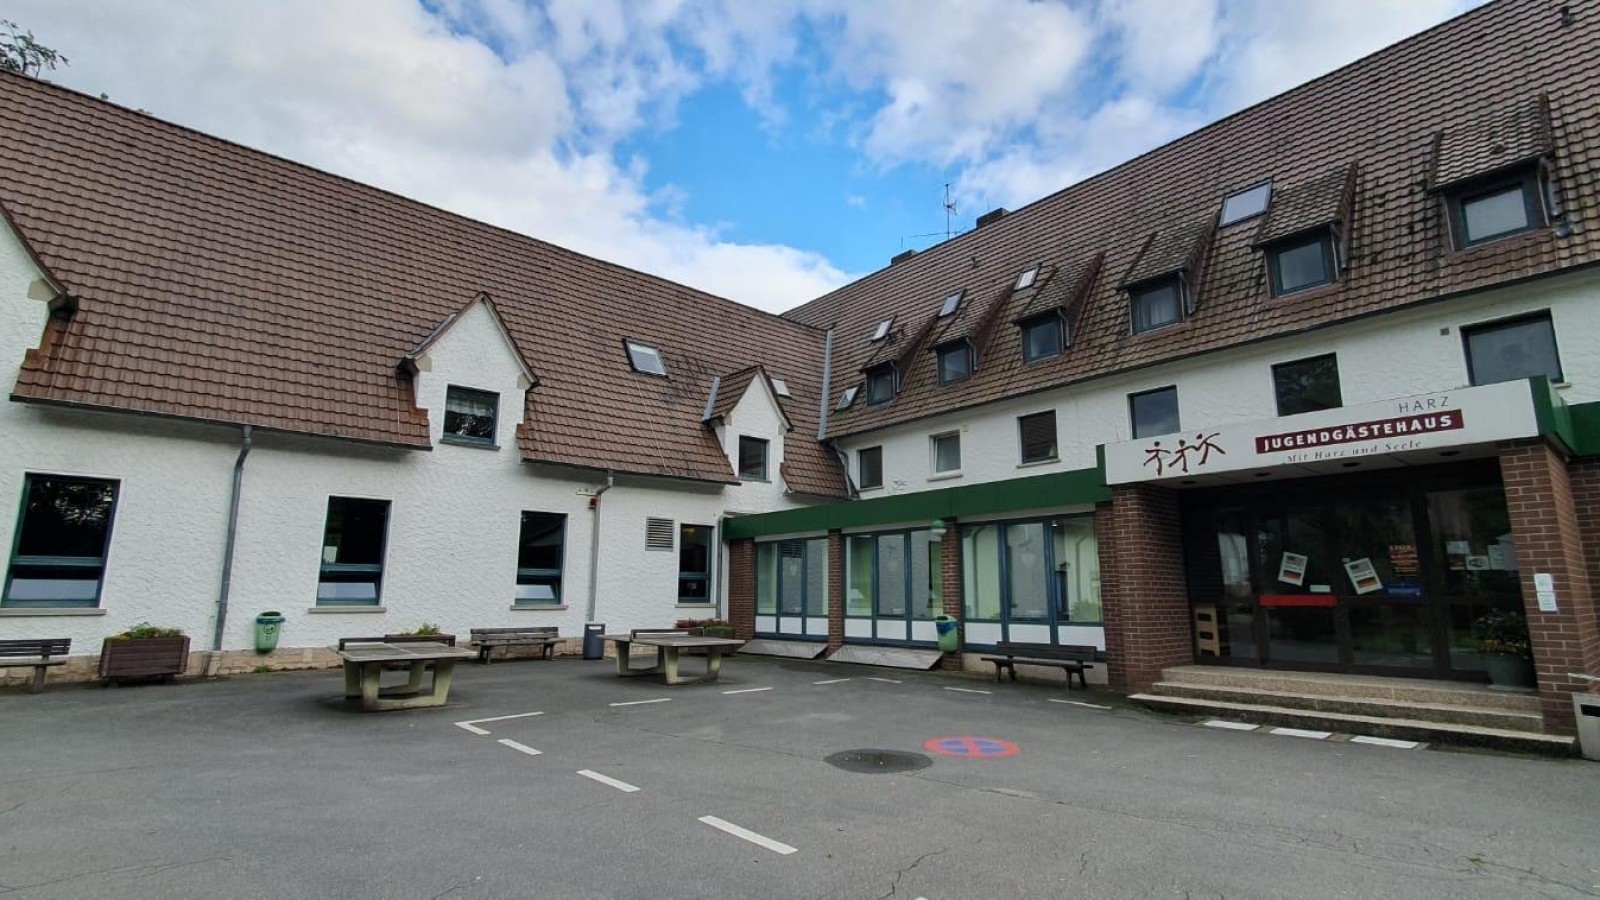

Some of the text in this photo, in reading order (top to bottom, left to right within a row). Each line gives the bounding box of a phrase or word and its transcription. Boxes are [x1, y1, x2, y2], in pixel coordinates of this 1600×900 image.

[1398, 396, 1449, 413] HARZ
[1264, 415, 1452, 451] JUGENDGÄSTEHAUS
[1287, 440, 1422, 463] Mit Harz und Seele
